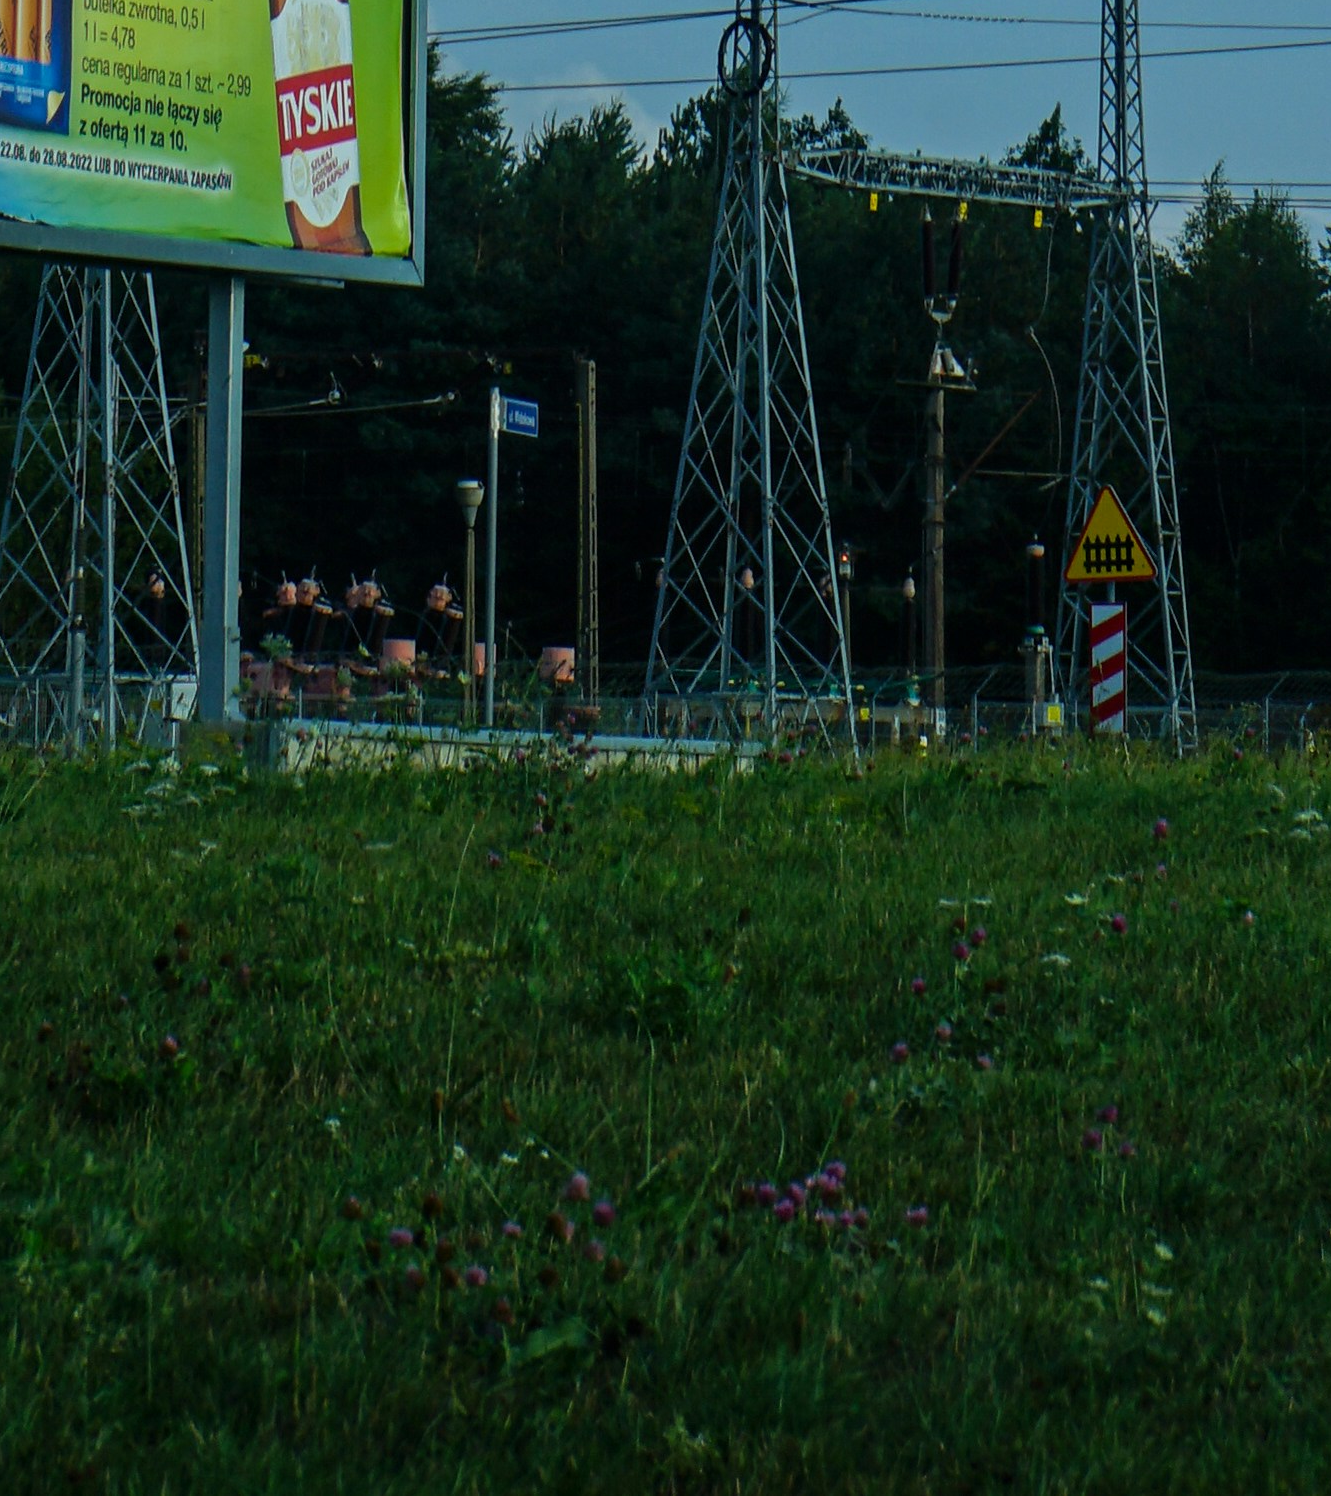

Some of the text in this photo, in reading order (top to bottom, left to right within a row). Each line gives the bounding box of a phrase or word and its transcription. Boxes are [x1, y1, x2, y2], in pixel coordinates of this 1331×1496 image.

[83, 22, 89, 41] 1
[111, 27, 136, 50] 4,78
[128, 1, 177, 28] zwrotna,
[181, 9, 199, 30] 0,5
[82, 55, 251, 98] cena regularna za 1 szt. 2,99
[81, 83, 223, 132] Promocja nie łączy się
[279, 78, 354, 141] TYSKIE
[79, 116, 188, 151] z ofertą 11 za 10.
[0, 141, 27, 161] 22.08.
[29, 146, 40, 164] do
[43, 148, 92, 171] 28.08.2022
[94, 156, 111, 174] LUB
[113, 159, 126, 177] DO
[128, 162, 189, 186] WYCZERPANIA
[191, 168, 232, 190] ZAPASÓW
